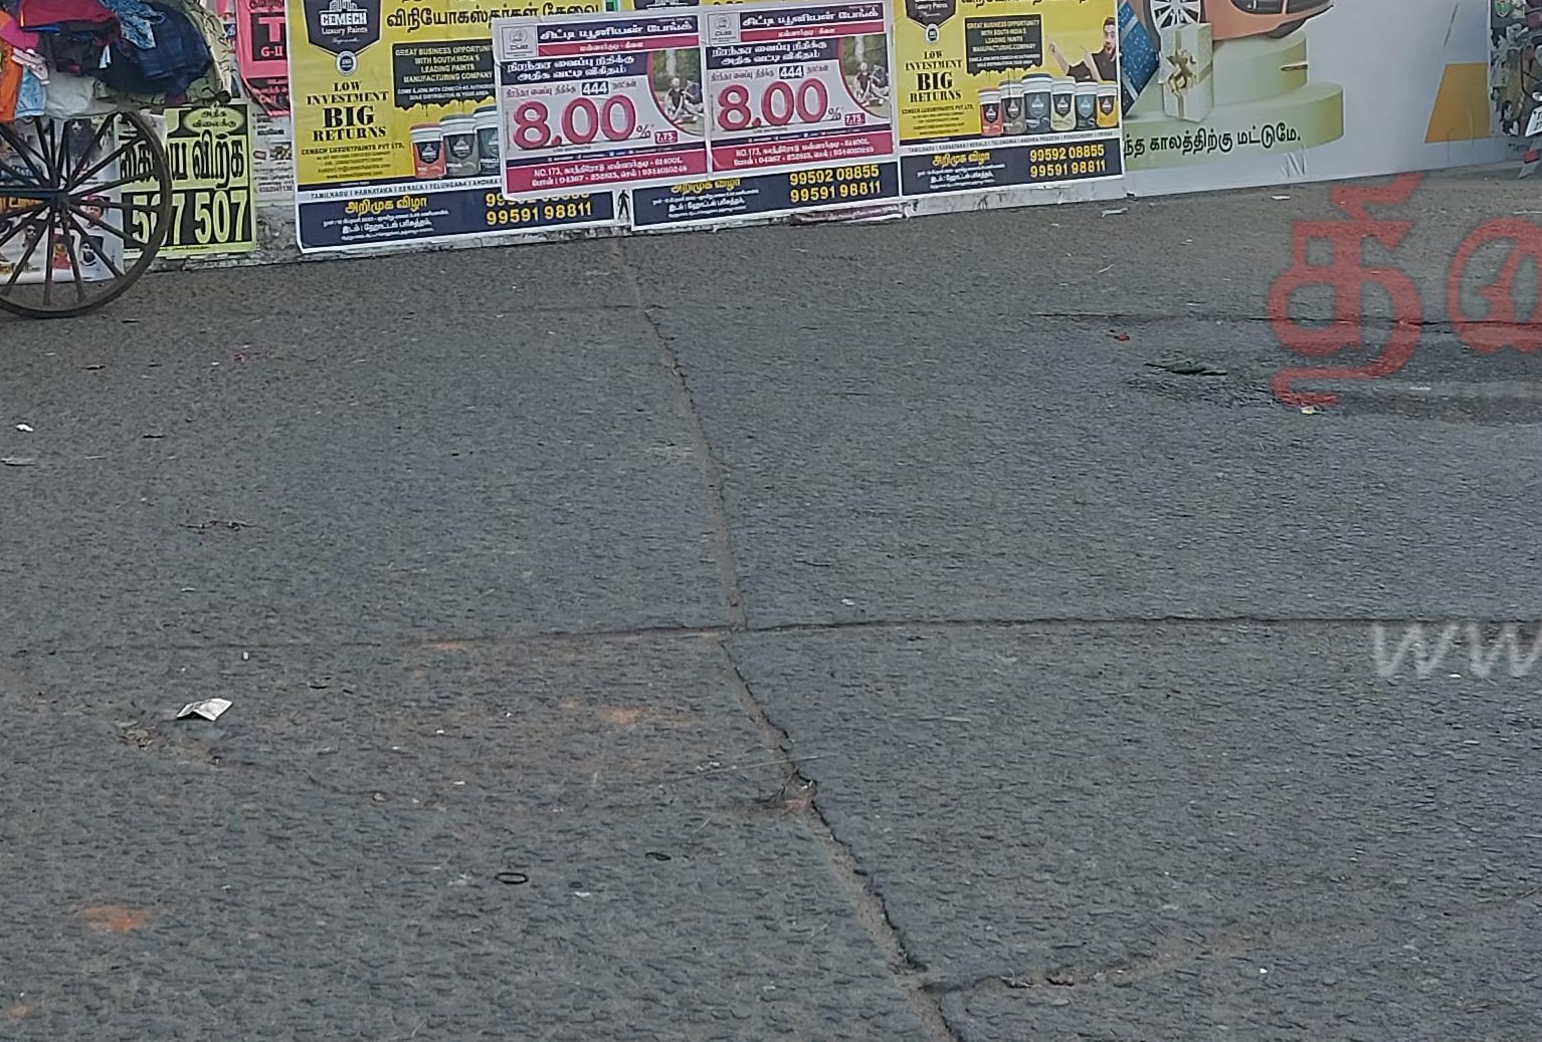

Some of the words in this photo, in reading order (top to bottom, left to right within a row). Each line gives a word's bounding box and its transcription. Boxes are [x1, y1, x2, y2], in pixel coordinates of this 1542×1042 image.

[320, 12, 368, 26] CEMECH
[321, 25, 346, 38] Luxury
[347, 24, 369, 35] Paints
[924, 50, 943, 59] LOW
[780, 66, 803, 78] 444
[905, 59, 963, 71] INVESTMENT
[333, 80, 361, 93] LOW
[582, 82, 608, 94] 444
[916, 71, 953, 91] BIG
[306, 91, 389, 105] INVESTMENT
[910, 90, 962, 103] RETURNS
[322, 105, 375, 129] BIG
[313, 125, 387, 142] RETURNS
[1149, 127, 1233, 156] காலத்திற்கு
[1237, 121, 1302, 149] மட்டுமே.
[192, 129, 245, 189] விற்க
[932, 153, 967, 170] அறிமுக
[968, 150, 991, 165] விழா
[1030, 148, 1066, 163] 99592
[1068, 144, 1105, 159] 08855
[790, 168, 833, 186] 99592
[837, 165, 880, 181] 08855
[1030, 164, 1068, 178] 99591
[1071, 160, 1106, 175] 98811
[790, 185, 836, 203] 99591
[840, 181, 881, 198] 98811
[345, 197, 393, 215] அறிமுக
[396, 194, 427, 212] விழா
[485, 209, 539, 225] 99591
[544, 202, 593, 220] 98811
[195, 190, 248, 244] 507
